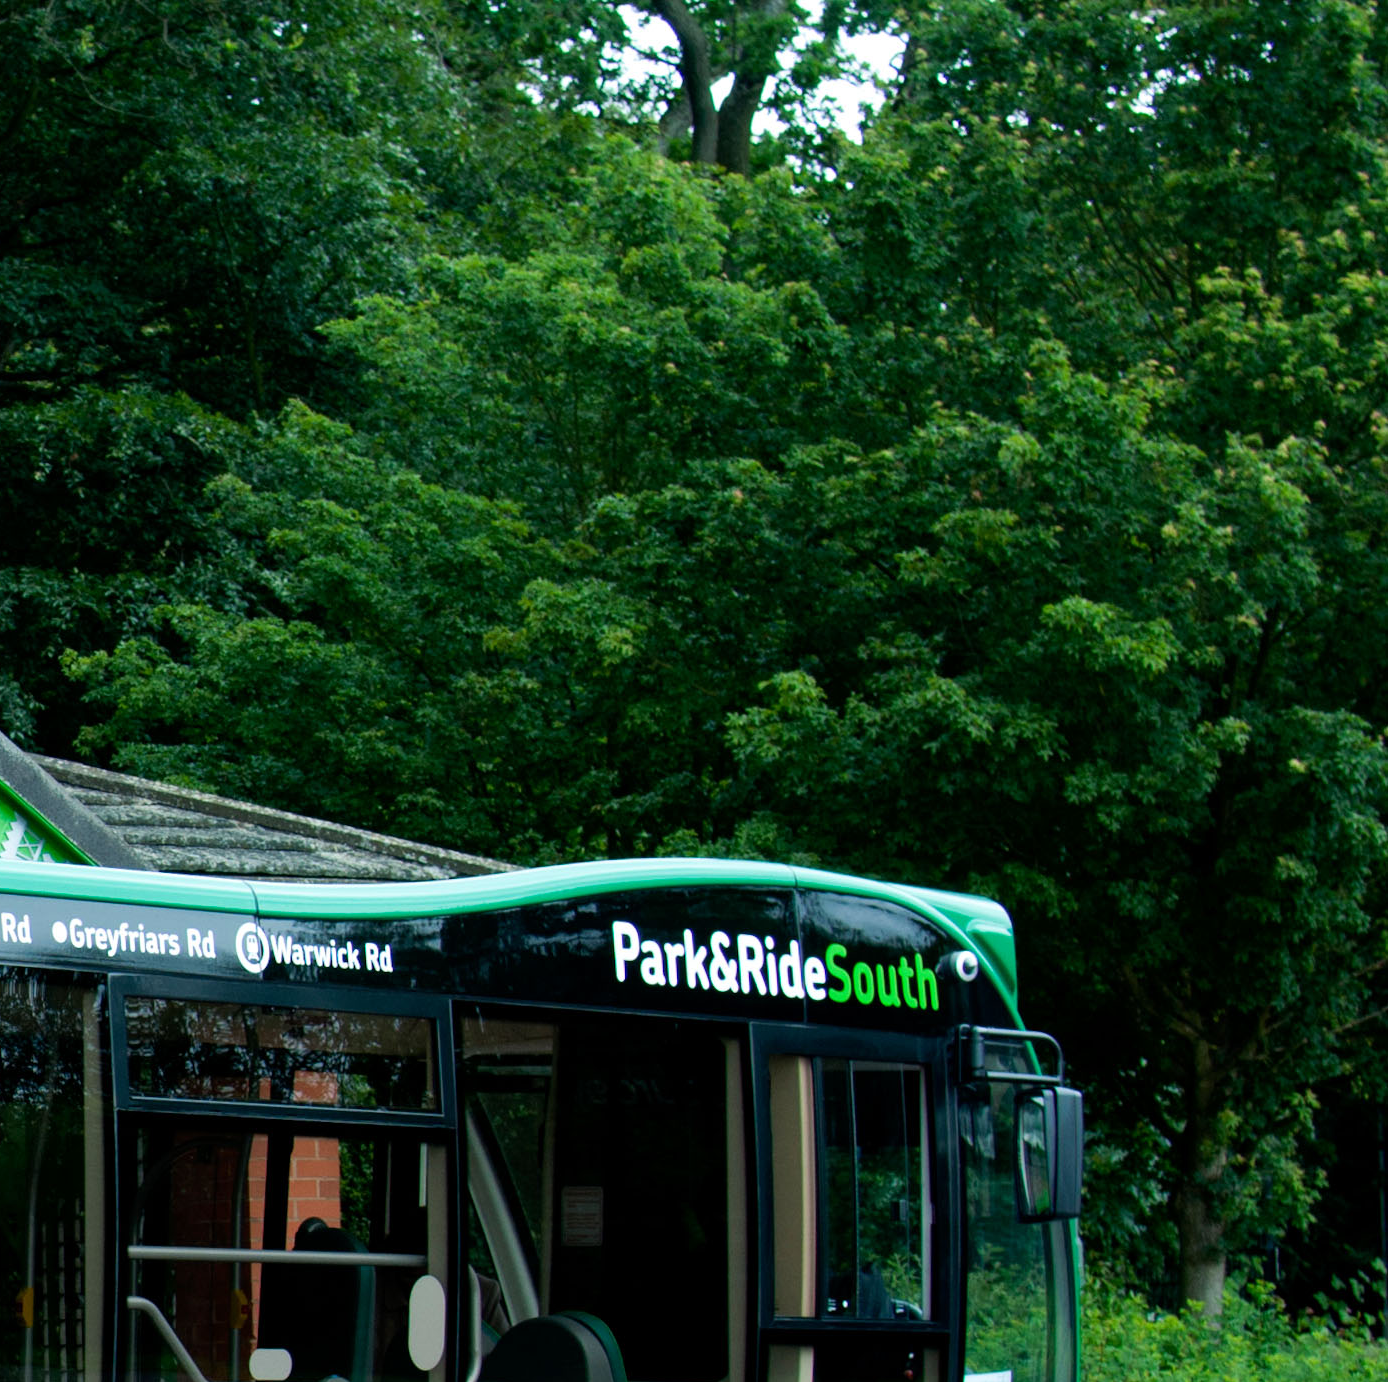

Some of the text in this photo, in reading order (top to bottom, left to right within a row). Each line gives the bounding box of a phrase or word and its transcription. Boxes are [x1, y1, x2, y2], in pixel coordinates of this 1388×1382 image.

[1, 912, 32, 945] Rd
[69, 917, 216, 960] Greyfriars Rd
[269, 933, 394, 974] Warwick Rd
